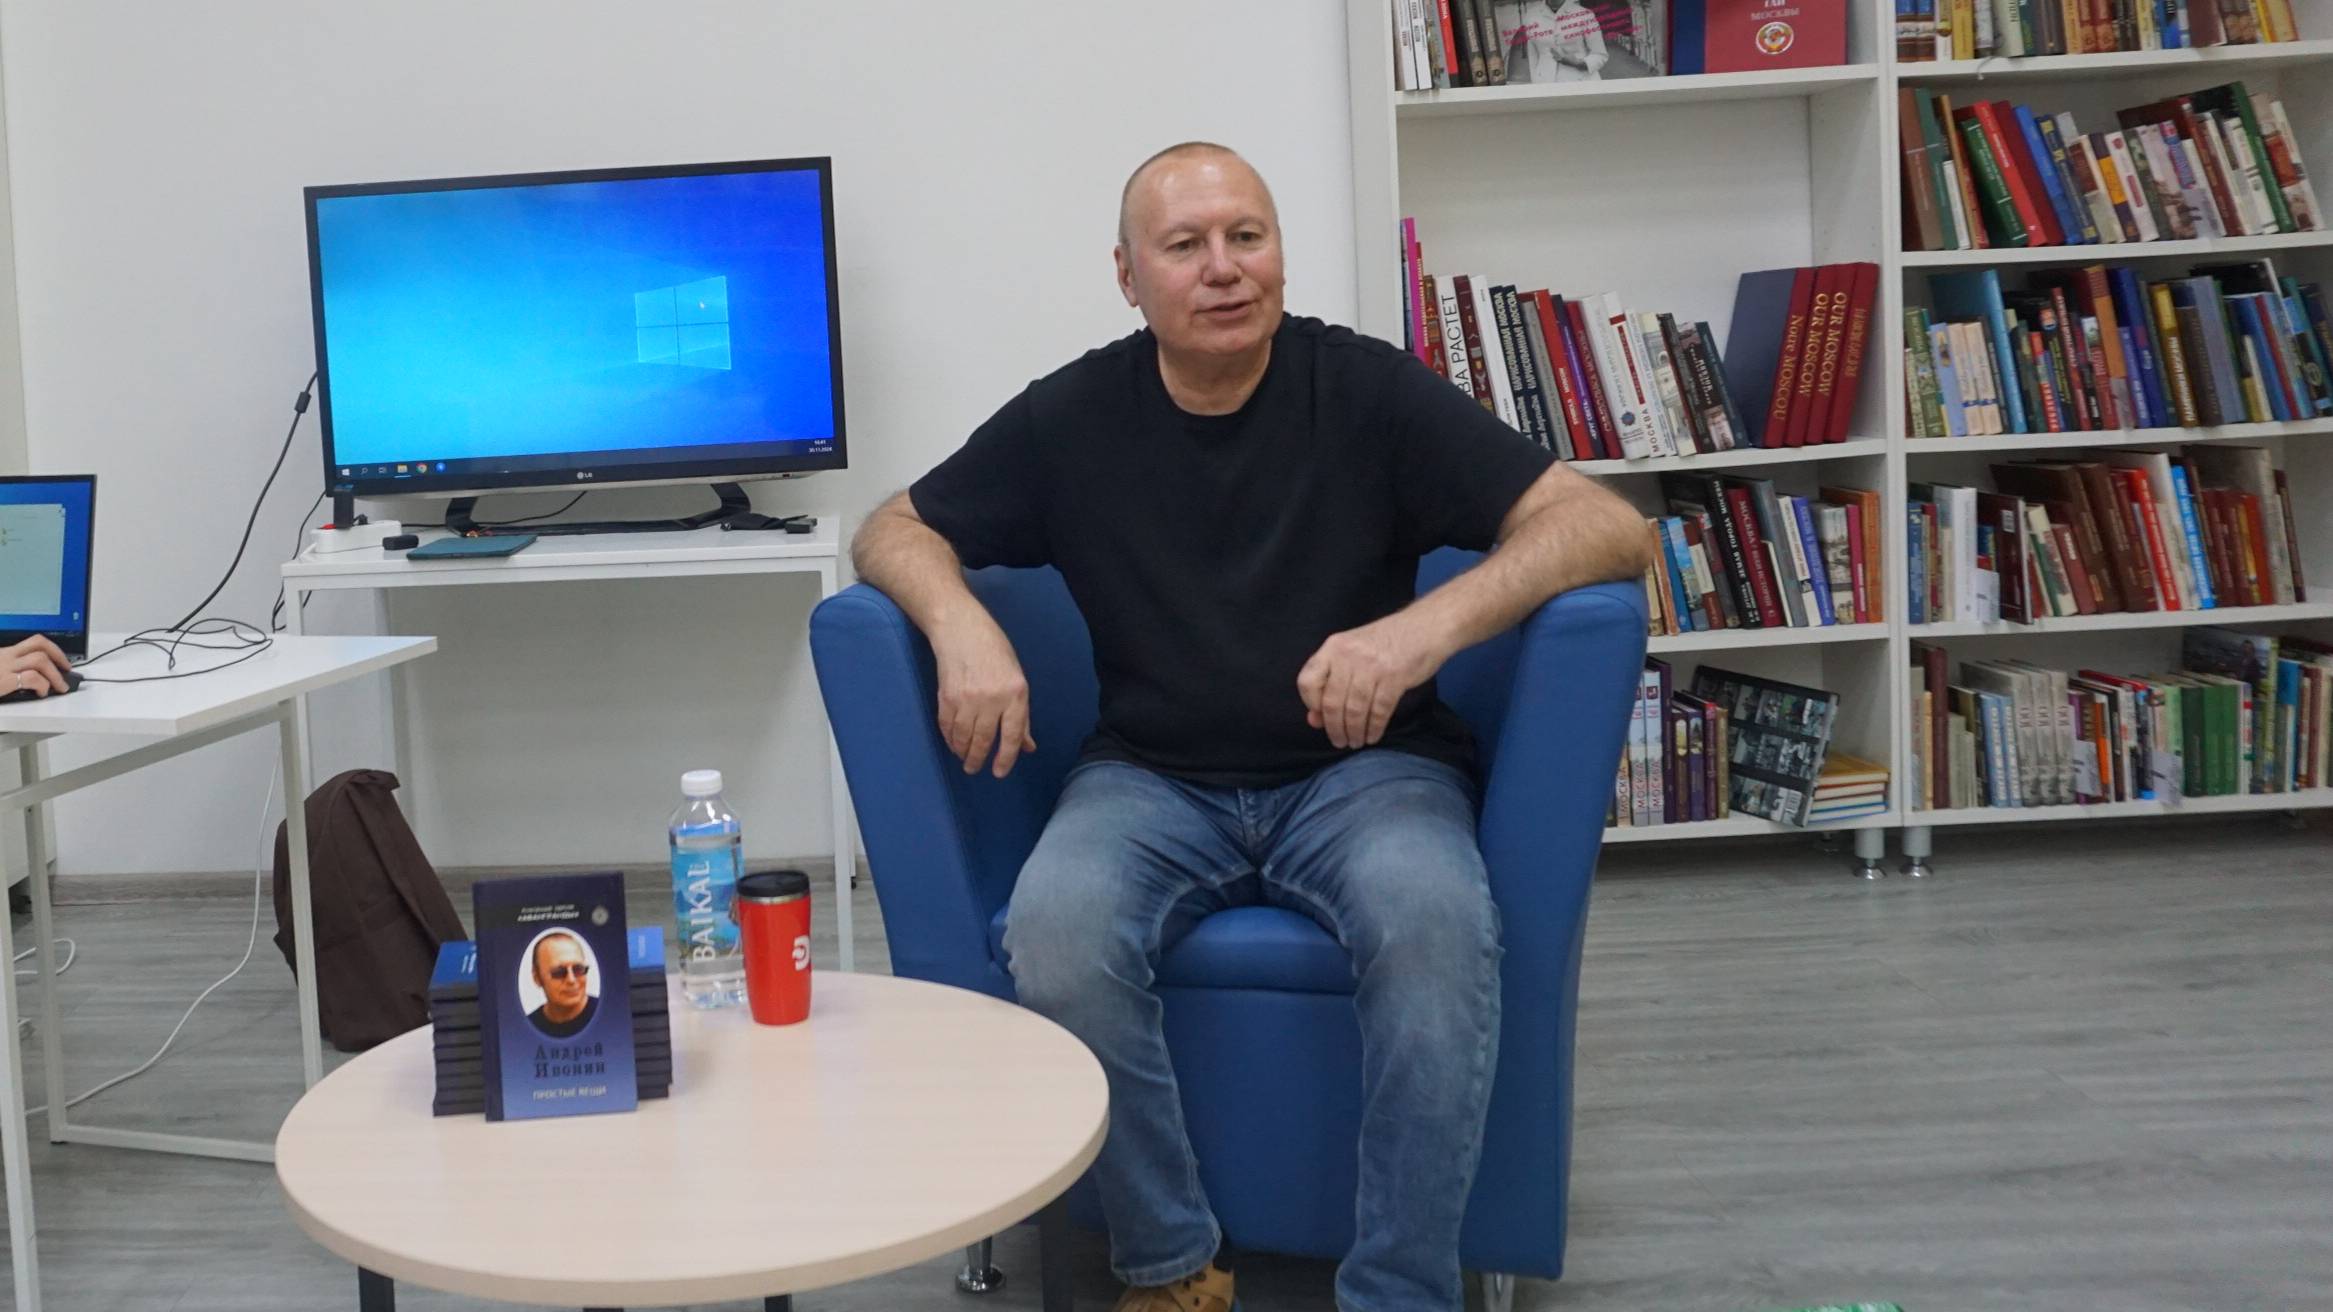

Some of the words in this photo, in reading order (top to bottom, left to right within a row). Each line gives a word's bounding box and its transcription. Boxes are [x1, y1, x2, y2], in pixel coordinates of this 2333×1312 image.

[1493, 292, 1507, 326] МОСКВА
[1506, 291, 1521, 325] МОСКВА
[1810, 293, 1829, 326] OUR
[1828, 292, 1847, 325] OUR
[1442, 294, 1465, 363] РАСТЕТ
[1799, 331, 1823, 396] MOSCOW
[1817, 329, 1840, 396] MOSCOW
[1772, 355, 1795, 420] MOSCOU
[1642, 408, 1660, 453] МОСКВА
[1713, 480, 1728, 514] МОСКВЫ
[1724, 517, 1738, 548] ГОРОДА
[1738, 500, 1756, 543] МОСКВА
[1733, 551, 1748, 579] ЗЕМЛЯ
[687, 861, 715, 962] BAIKAL
[534, 1041, 604, 1061] Андрей
